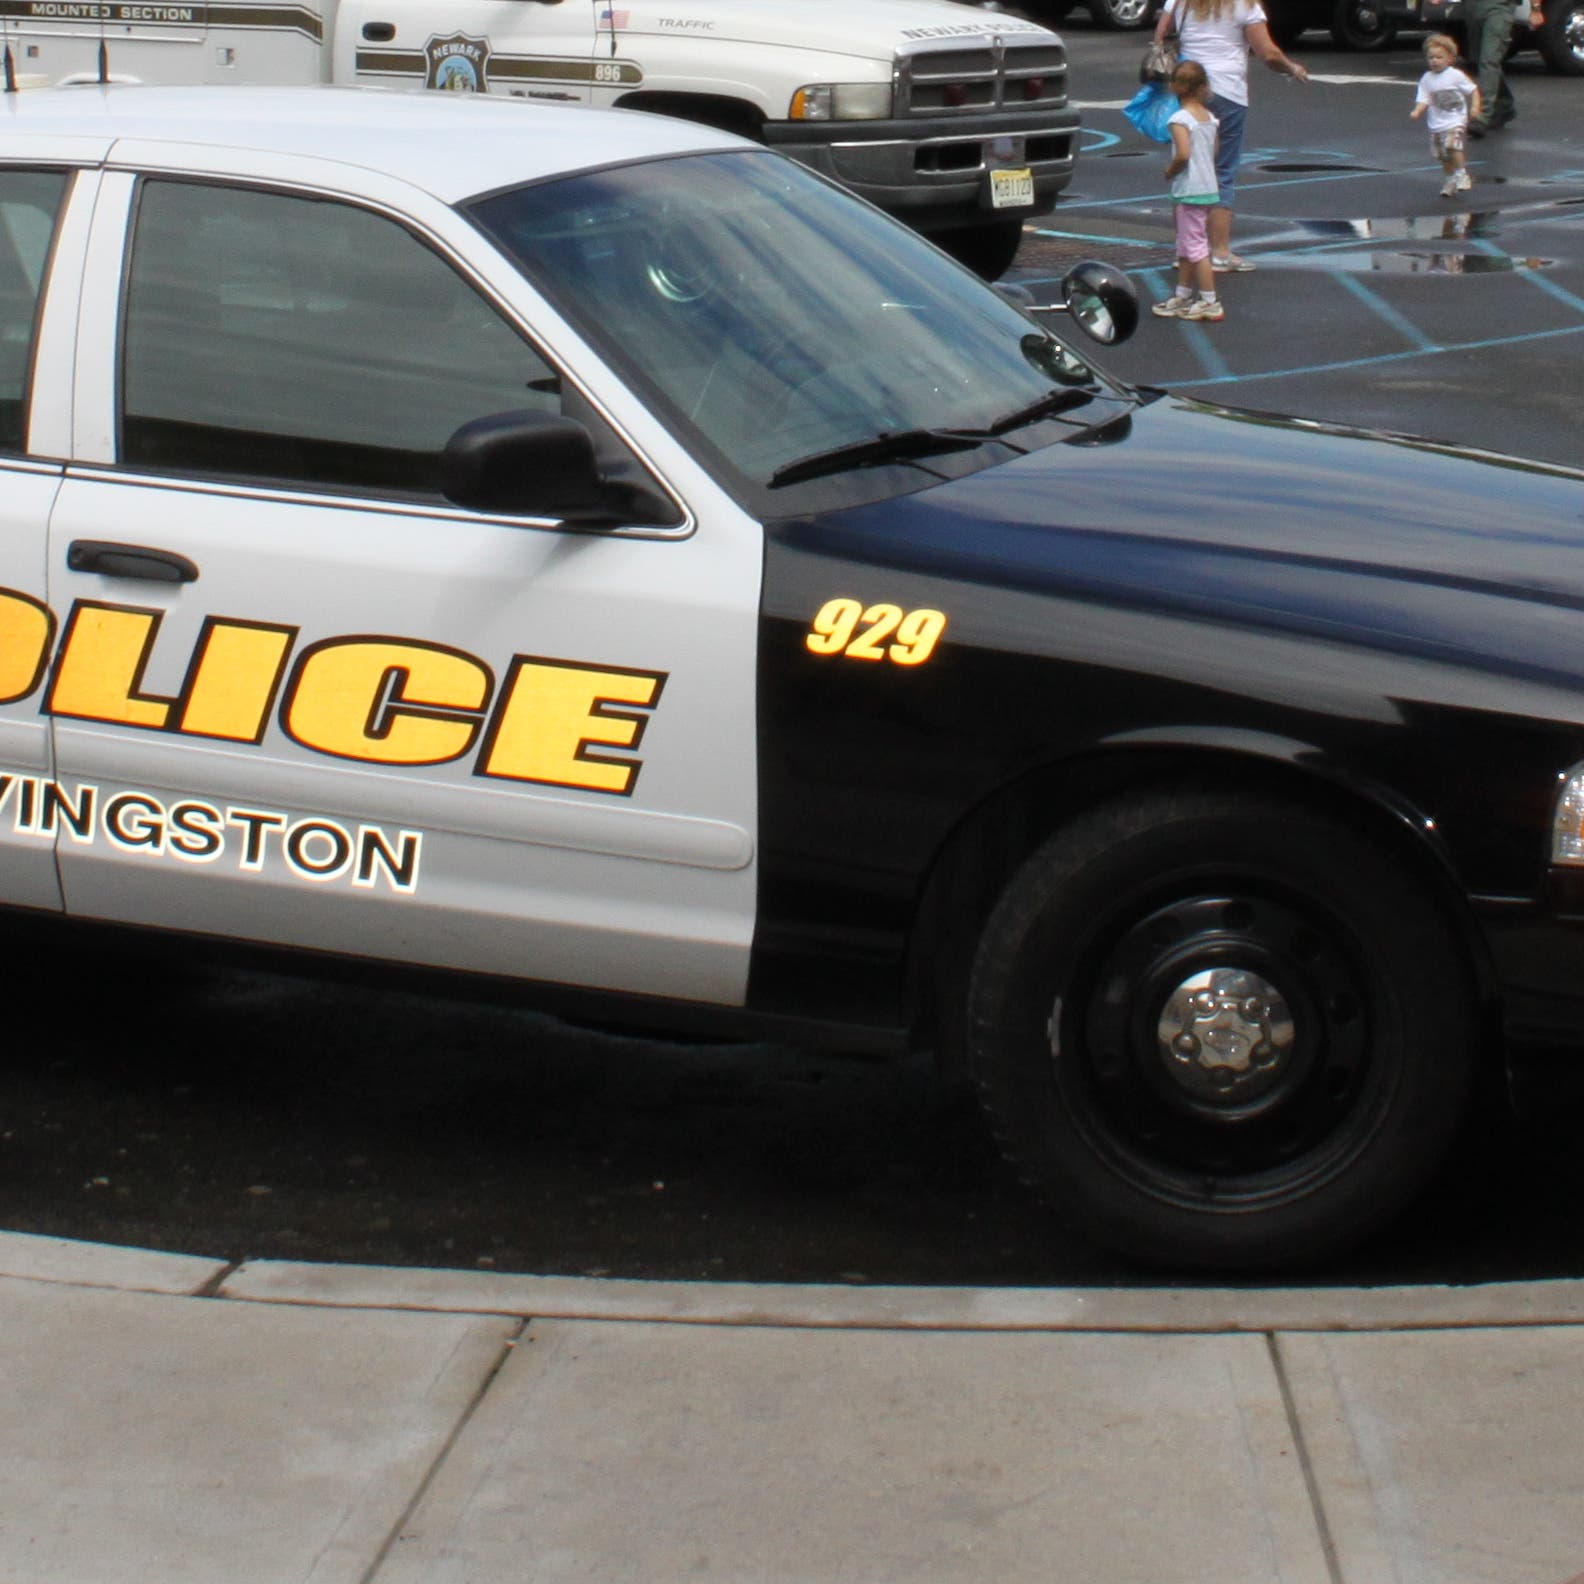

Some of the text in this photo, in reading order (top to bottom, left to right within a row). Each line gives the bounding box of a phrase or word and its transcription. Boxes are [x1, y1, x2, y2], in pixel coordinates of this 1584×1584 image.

[31, 1, 193, 21] MOUNTED SECTION
[658, 18, 715, 31] TRAFFIC
[433, 43, 482, 61] NEWARK
[595, 65, 620, 80] 896
[806, 598, 946, 666] 929
